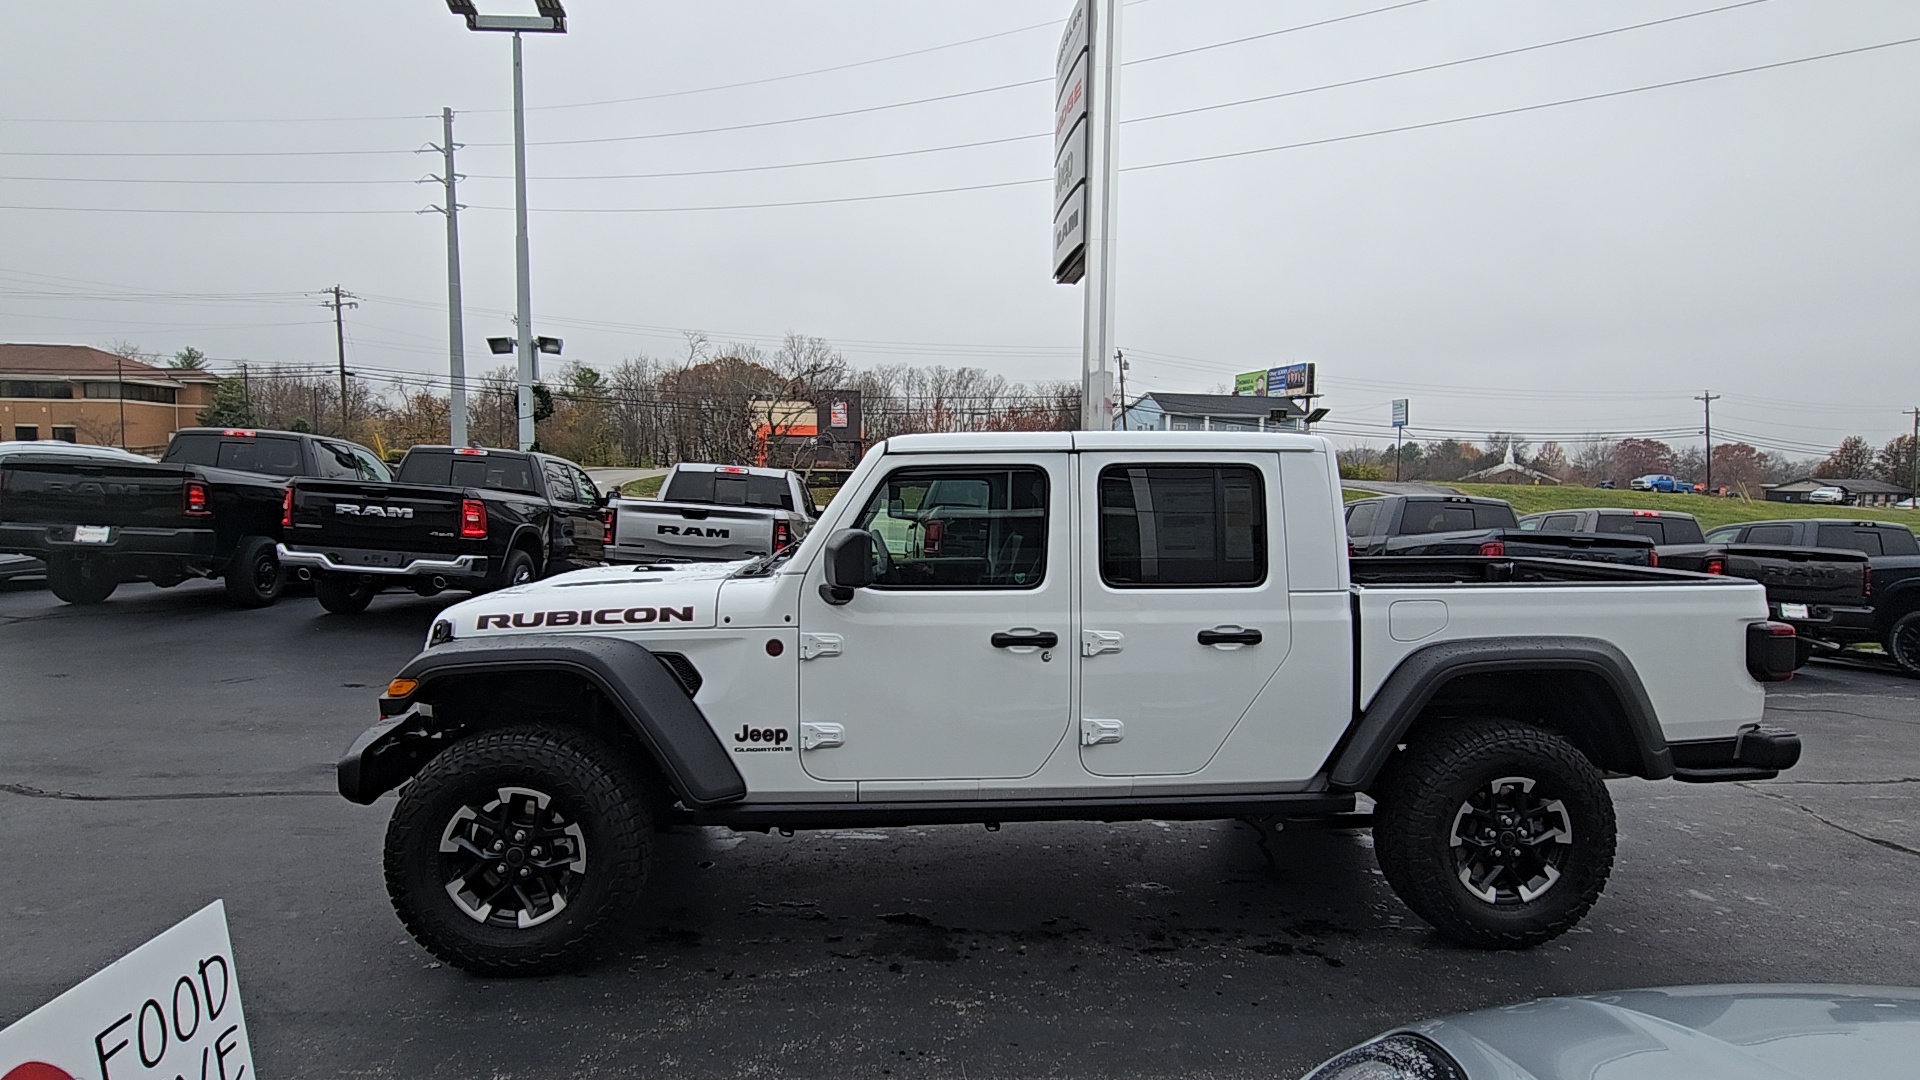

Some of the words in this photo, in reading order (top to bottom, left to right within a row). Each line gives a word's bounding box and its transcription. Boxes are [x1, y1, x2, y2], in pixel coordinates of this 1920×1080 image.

[1055, 78, 1082, 145] ODGE
[44, 480, 140, 496] RAM
[335, 503, 414, 519] RAM
[657, 524, 730, 539] RAM
[476, 605, 695, 631] RUBICON
[734, 724, 788, 745] Jeep
[95, 955, 229, 1080] FOOD
